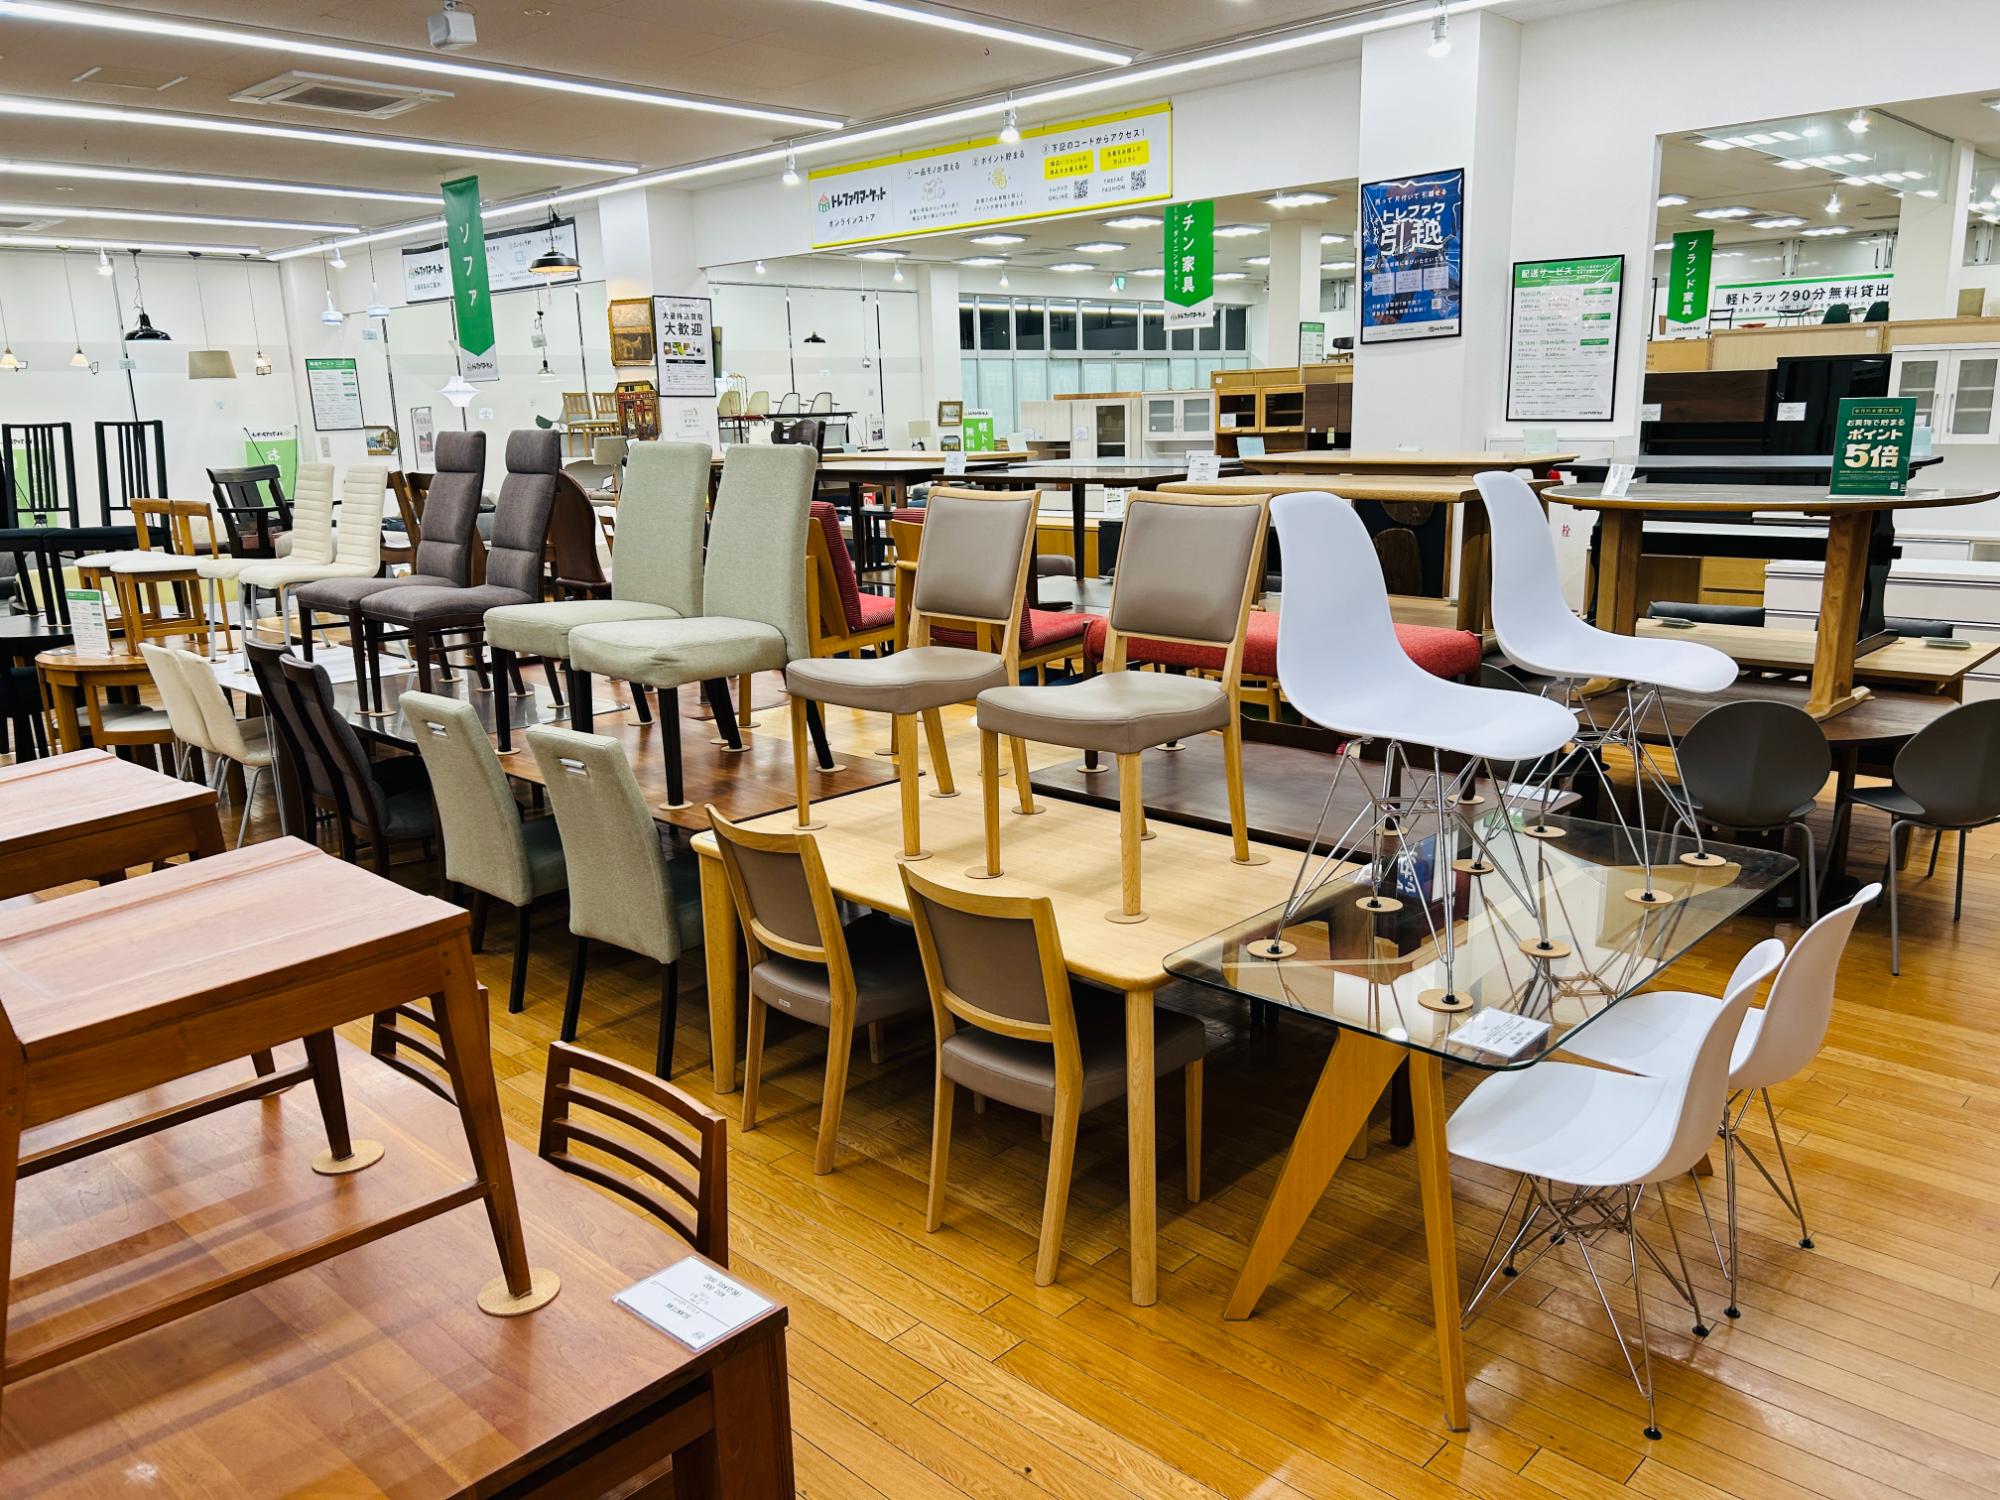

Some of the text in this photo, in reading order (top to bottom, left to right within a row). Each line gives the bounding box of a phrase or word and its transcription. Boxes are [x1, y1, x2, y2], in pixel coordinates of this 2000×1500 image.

[831, 186, 886, 208] トレファクマーケット
[829, 213, 875, 228] オンラインストア
[1383, 201, 1445, 222] トレファク
[1182, 202, 1195, 293] チン家具
[1380, 217, 1444, 256] 引越
[1681, 239, 1698, 316] ブランド家具
[1725, 283, 1889, 306] 軽トラック90分無料貸出
[664, 321, 703, 336] 大歓迎
[1847, 429, 1904, 441] ポイント
[1844, 443, 1900, 468] 5倍
